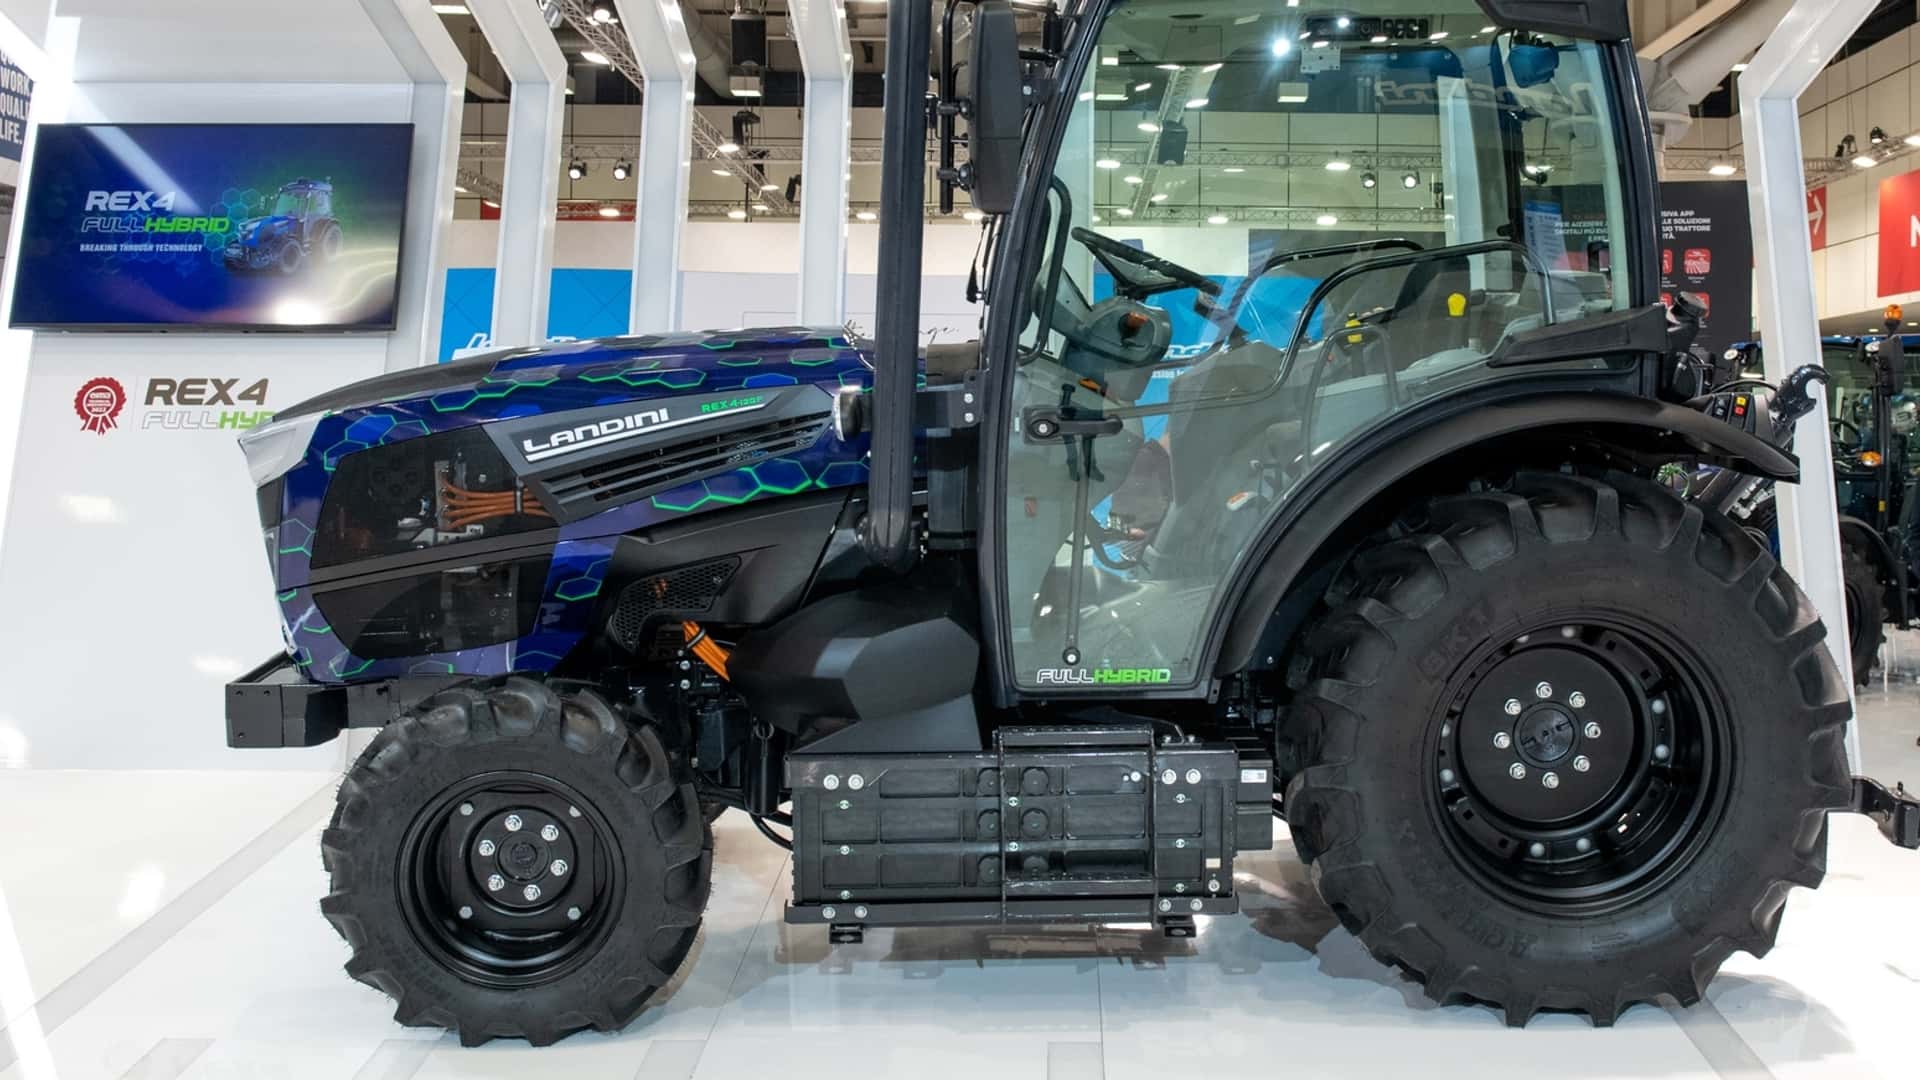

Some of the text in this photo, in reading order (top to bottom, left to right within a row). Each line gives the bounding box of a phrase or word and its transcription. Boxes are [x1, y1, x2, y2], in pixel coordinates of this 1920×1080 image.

[0, 66, 30, 97] WORK
[80, 244, 203, 252] BREAKING THROUGH TECHNOLOGY
[523, 407, 670, 453] LANDINI
